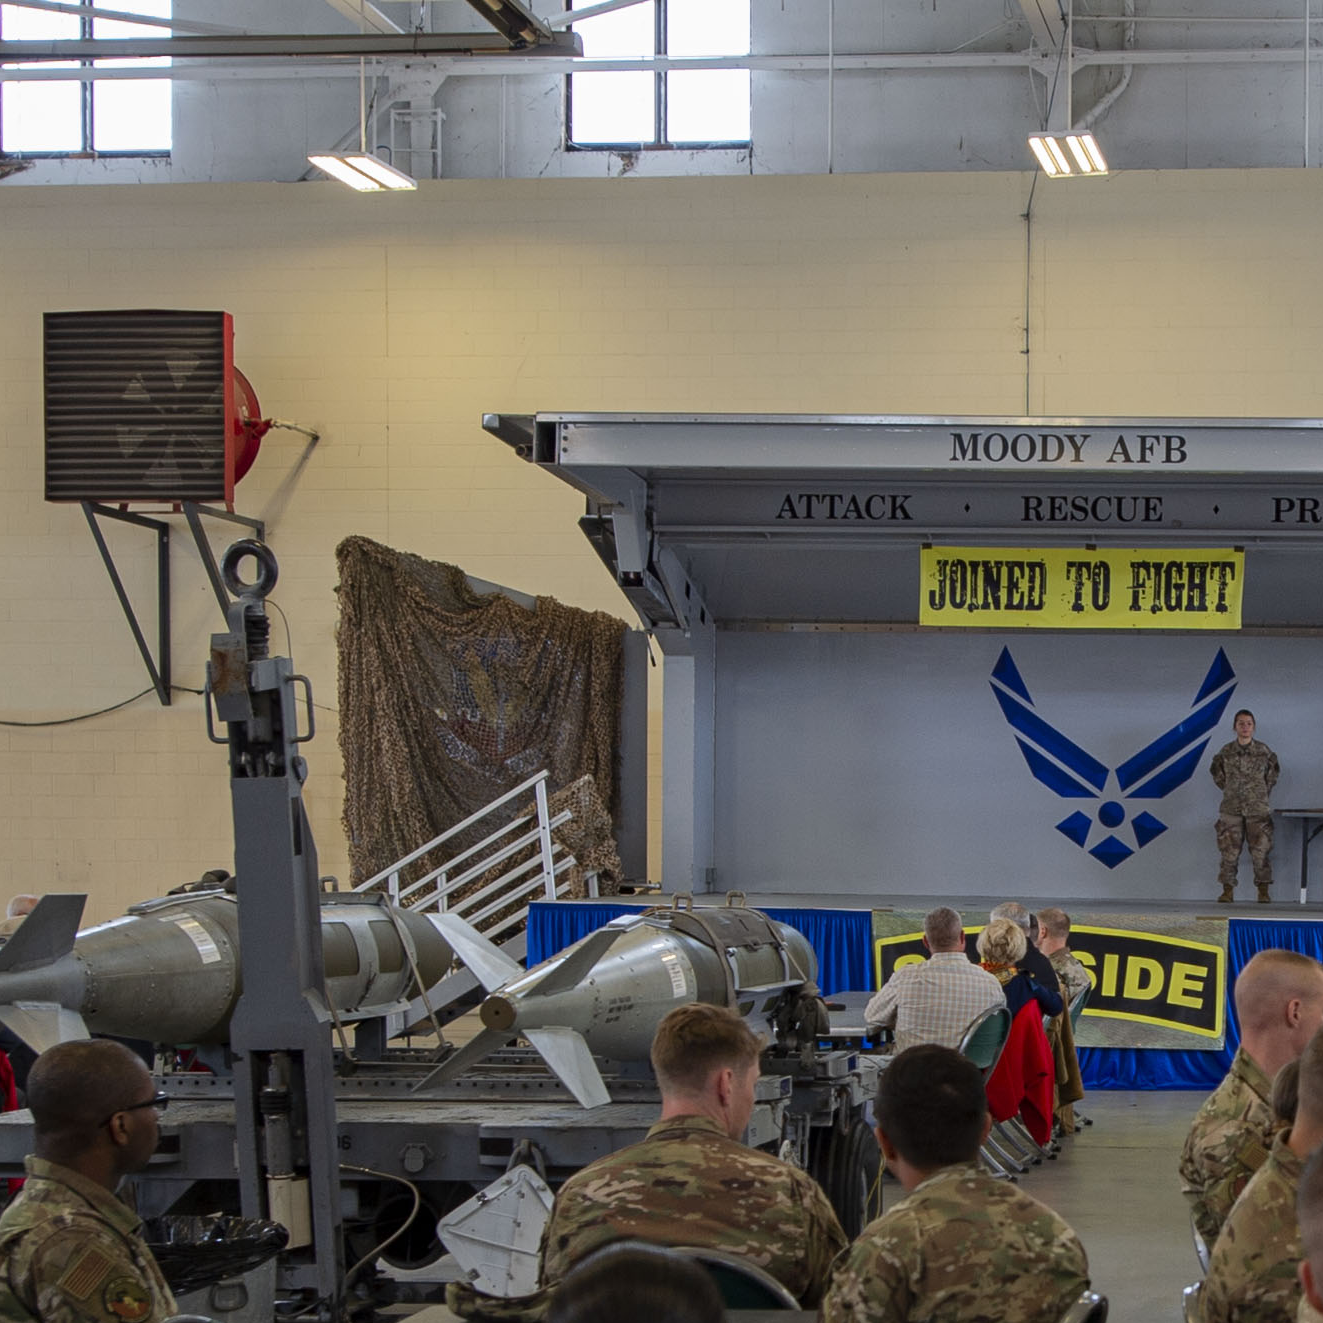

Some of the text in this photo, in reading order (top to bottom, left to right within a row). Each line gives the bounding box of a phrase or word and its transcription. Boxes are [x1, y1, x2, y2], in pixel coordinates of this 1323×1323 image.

[949, 432, 1187, 463] MOODY AFB
[776, 494, 913, 520] ATTACK
[1021, 495, 1164, 523] RESCUE
[929, 558, 1236, 614] JOINED TO FIGHT
